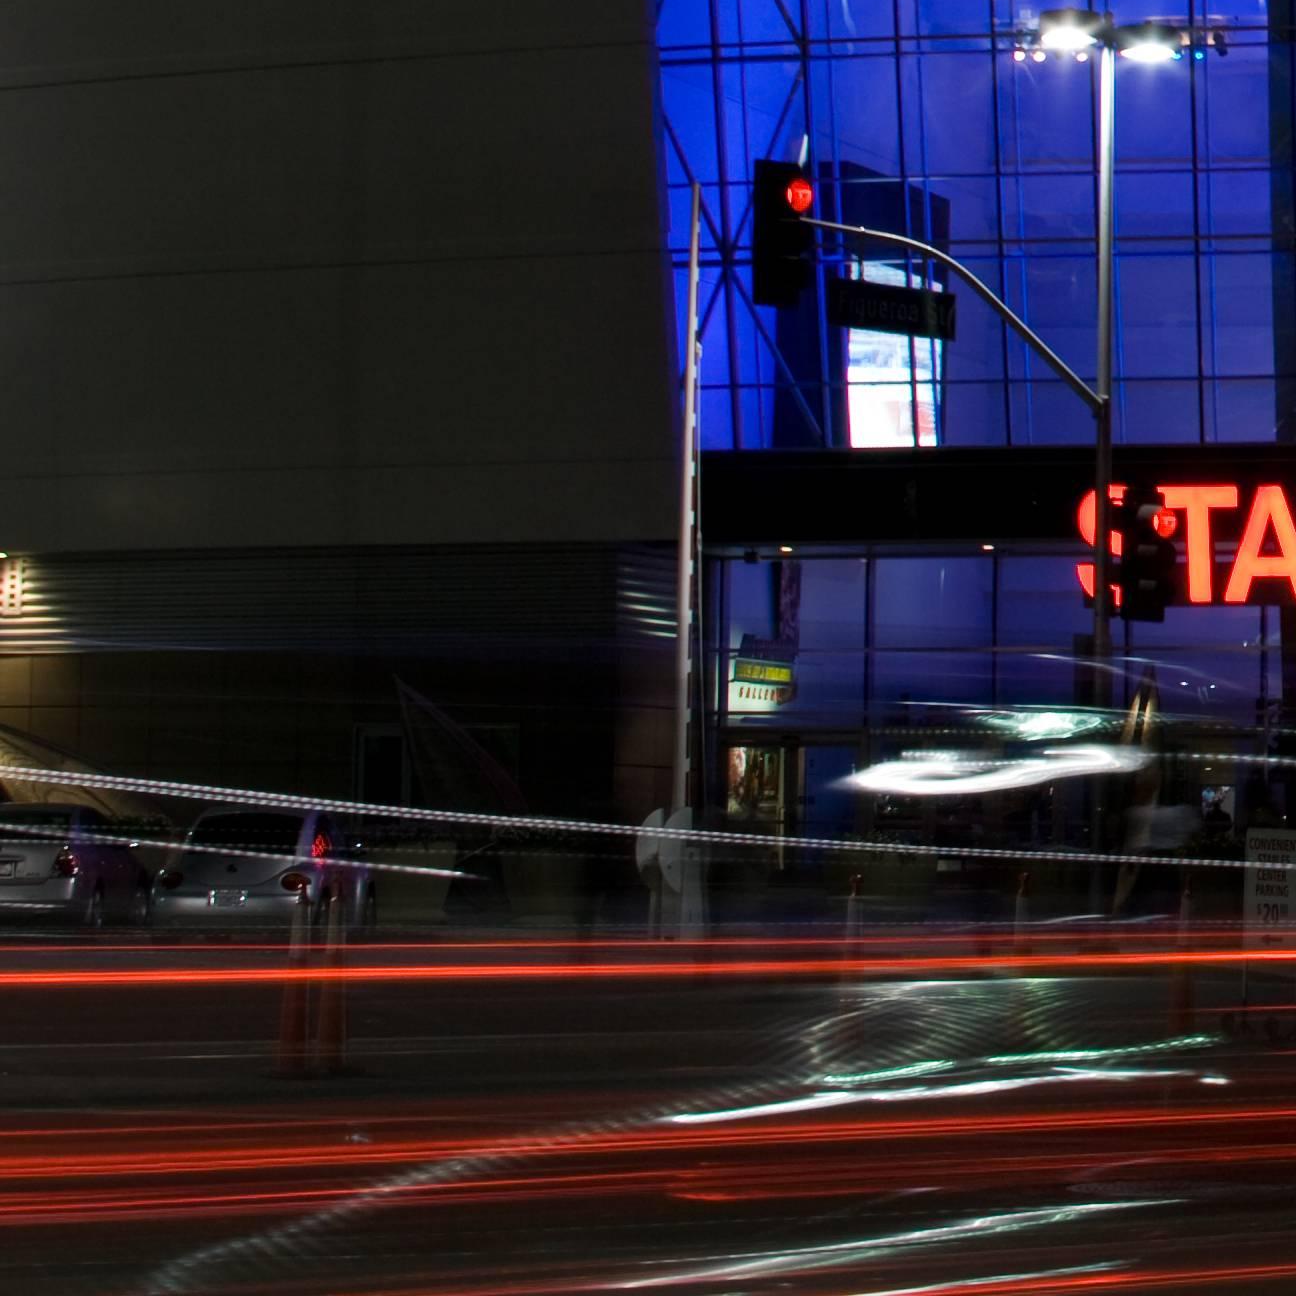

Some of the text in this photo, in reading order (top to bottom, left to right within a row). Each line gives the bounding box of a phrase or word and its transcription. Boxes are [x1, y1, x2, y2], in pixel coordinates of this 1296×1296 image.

[838, 289, 920, 323] Figueroa
[1256, 869, 1287, 882] CENTER
[1255, 883, 1289, 897] PARKING
